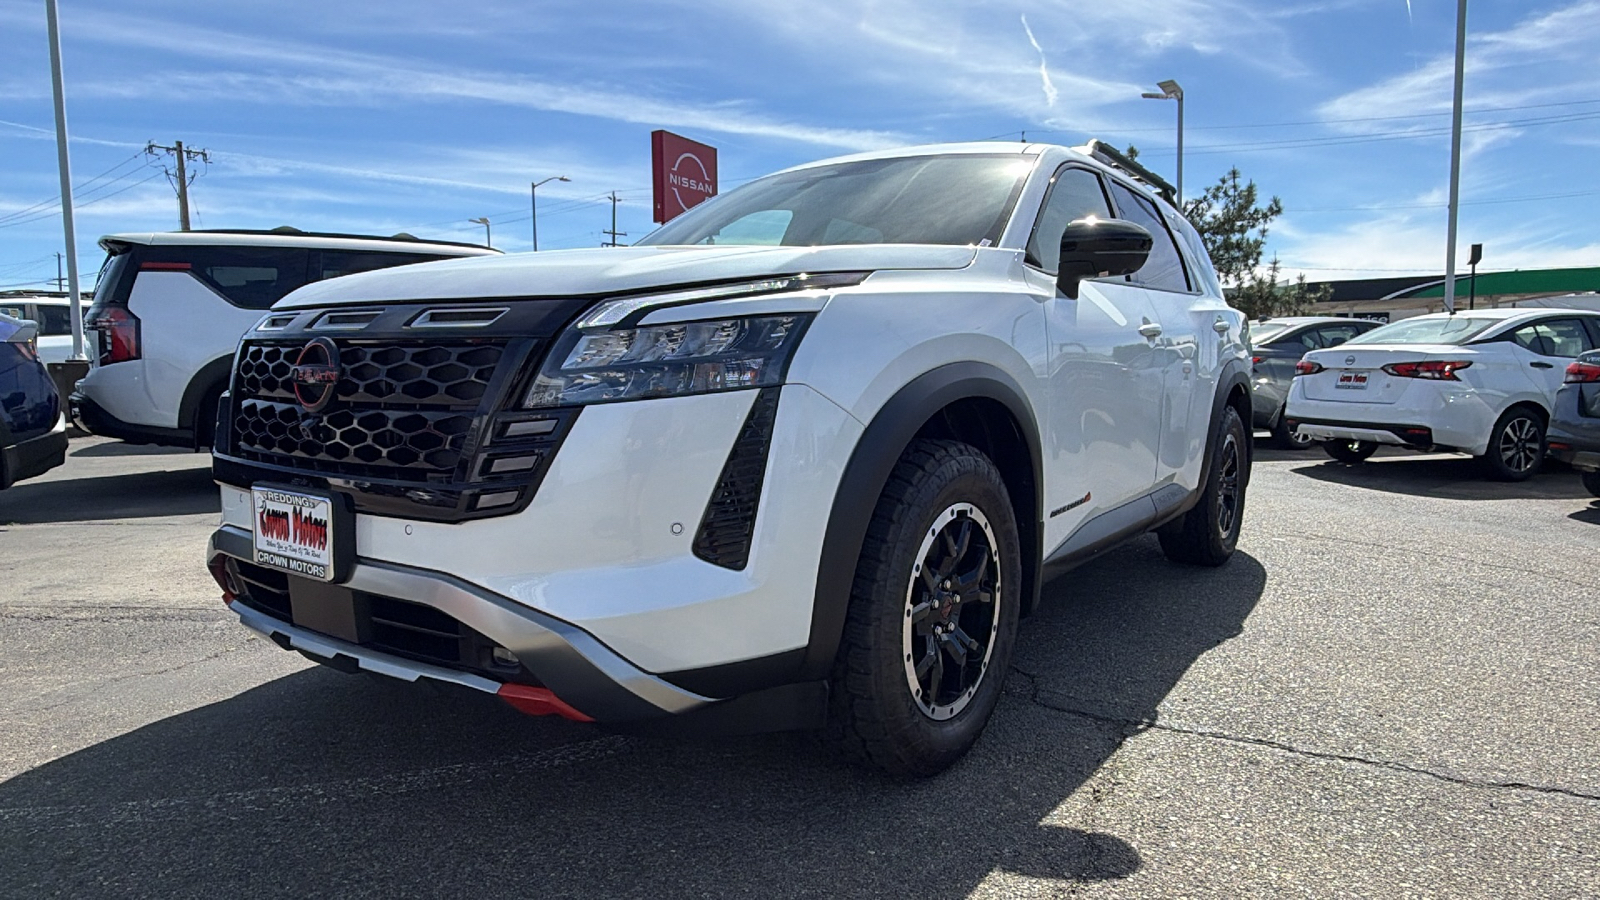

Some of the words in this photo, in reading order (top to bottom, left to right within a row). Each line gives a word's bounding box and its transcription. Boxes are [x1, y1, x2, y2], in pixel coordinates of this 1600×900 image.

[669, 173, 712, 194] NISSAN
[267, 491, 309, 507] REDDING
[260, 503, 290, 542] Crown
[292, 505, 328, 552] Motors
[258, 551, 287, 568] CROWN
[289, 559, 325, 578] MOTORS
